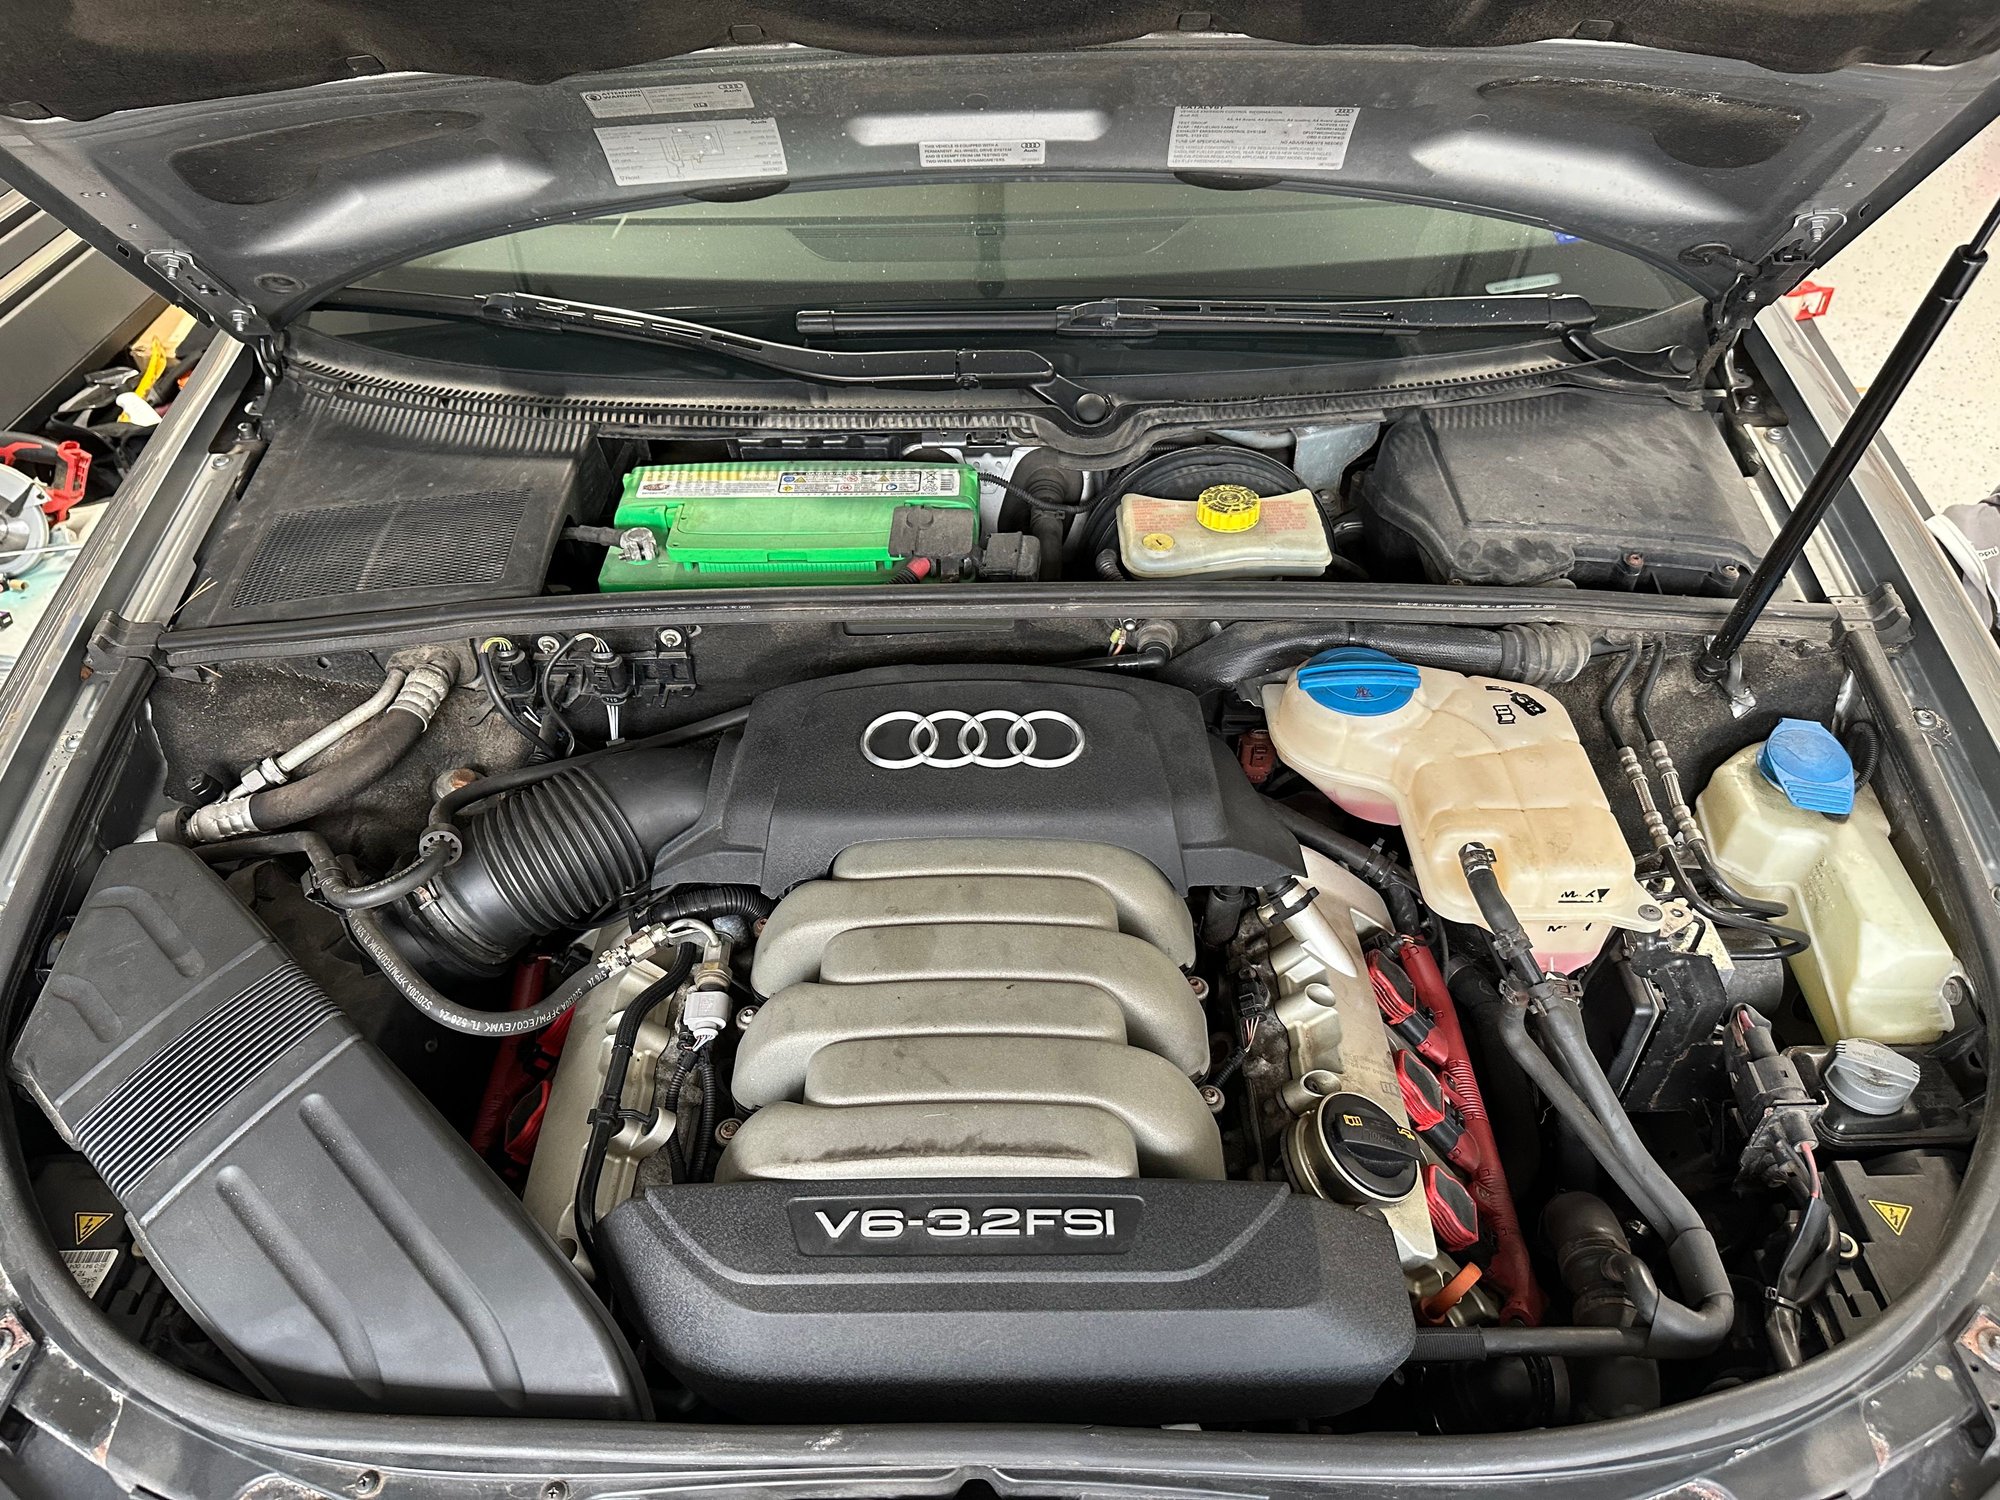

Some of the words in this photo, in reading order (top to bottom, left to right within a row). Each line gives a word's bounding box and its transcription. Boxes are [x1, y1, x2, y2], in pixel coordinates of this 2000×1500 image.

[1560, 889, 1596, 898] MX
[405, 984, 433, 1010] S20130A
[471, 1020, 481, 1031] TL
[815, 1208, 1115, 1239] V6-3.2FSI
